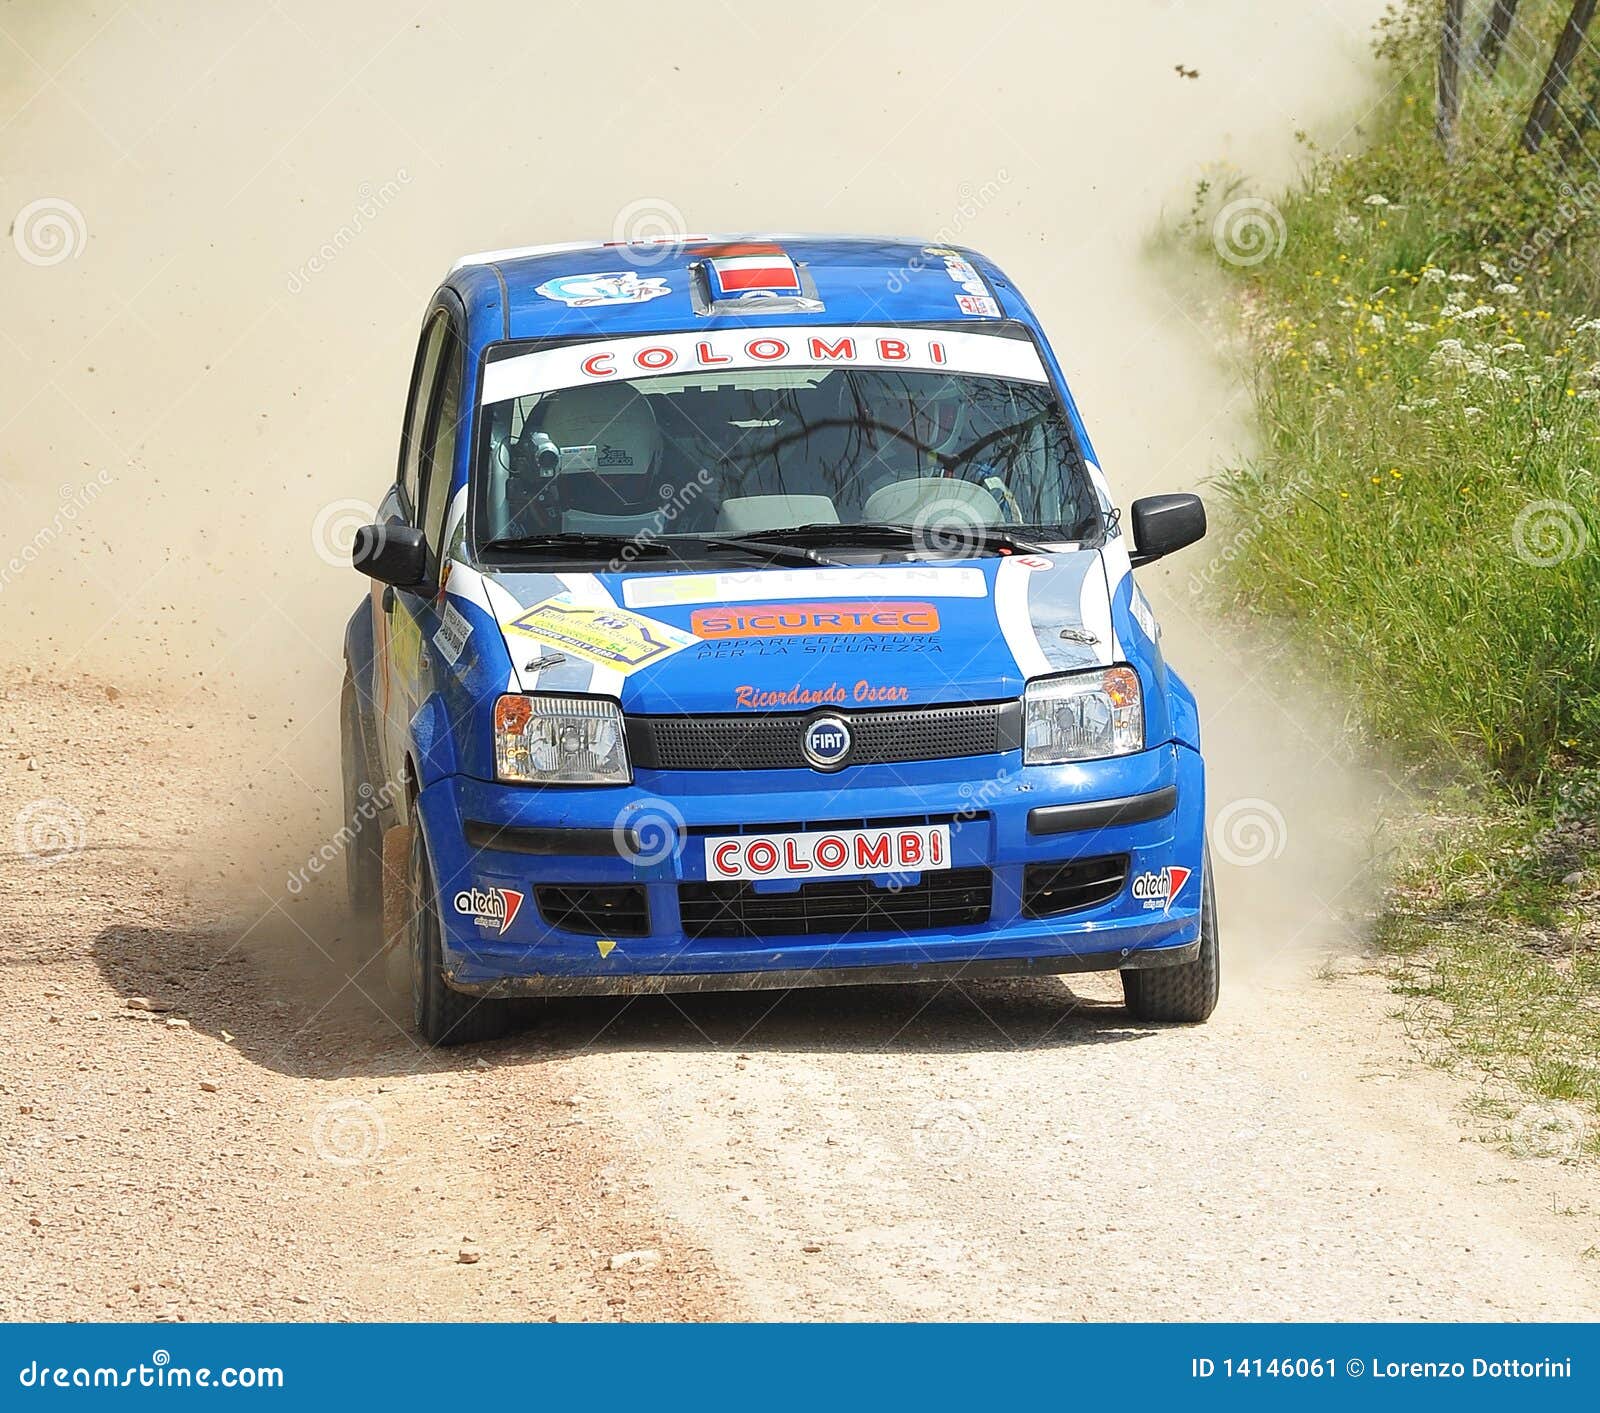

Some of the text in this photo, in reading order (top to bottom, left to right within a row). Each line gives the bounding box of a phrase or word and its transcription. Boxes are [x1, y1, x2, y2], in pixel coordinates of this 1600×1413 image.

[581, 336, 948, 378] COLOMBI
[703, 611, 930, 633] SICURTEC
[562, 635, 592, 650] RALLY
[697, 634, 943, 650] APPARECCHIATURE
[697, 643, 944, 660] PER LA SICUREZZA
[735, 680, 911, 710] Ricordando Oscar
[812, 733, 843, 750] FIAT
[713, 829, 944, 877] COLOMBI
[1132, 867, 1170, 898] atech
[454, 888, 504, 917] atech
